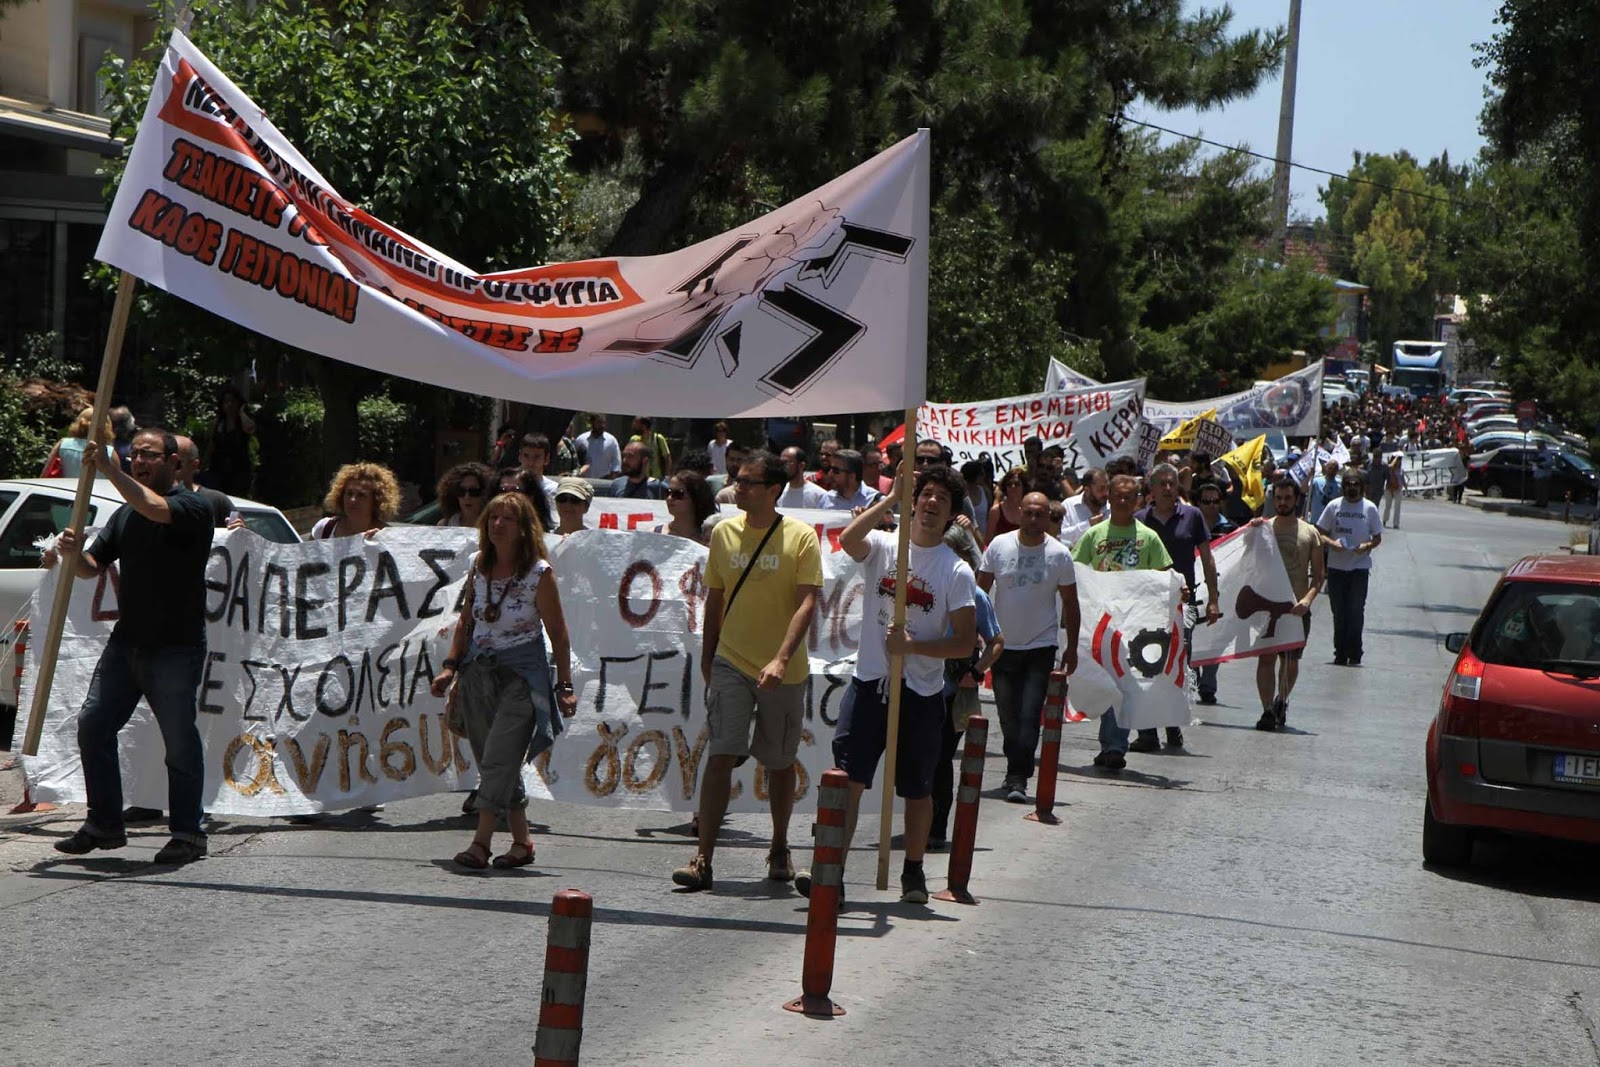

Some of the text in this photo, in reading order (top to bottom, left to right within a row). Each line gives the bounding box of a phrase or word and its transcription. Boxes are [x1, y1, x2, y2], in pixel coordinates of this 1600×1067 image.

[128, 188, 361, 324] ΚΑΘΕ ΓΕΙΤΟΝΙΑ!
[163, 137, 290, 230] ΤΣΑΚΙΣΤΕ
[532, 326, 583, 353] ΣΕ
[948, 420, 1073, 447] ΝΙΚΗΜΕΝΟΙ
[995, 392, 1112, 424] ΕΝΩΜΕΝΟΙ
[258, 548, 466, 640] ΠΕΡΑΣ
